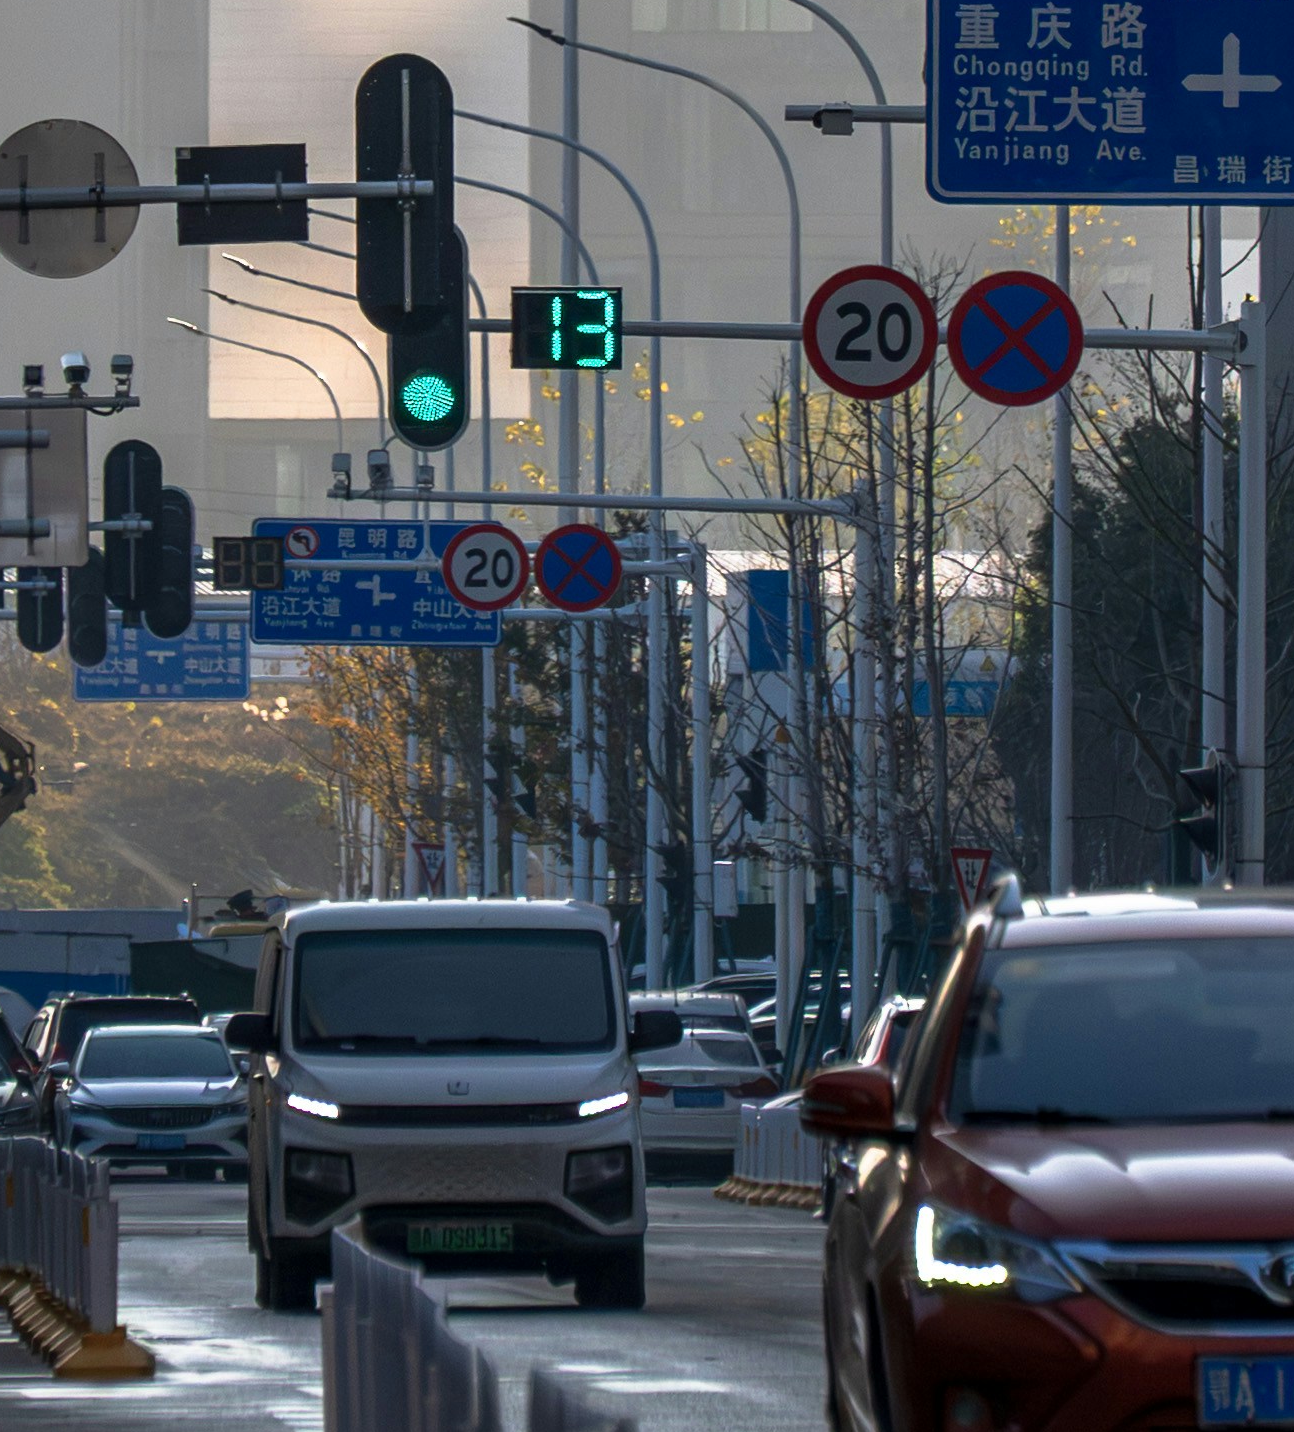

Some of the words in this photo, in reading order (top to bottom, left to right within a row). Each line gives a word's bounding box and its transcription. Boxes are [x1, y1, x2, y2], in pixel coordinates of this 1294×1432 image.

[954, 2, 1148, 50] 重庆路
[954, 54, 1090, 81] Chongqing
[1111, 55, 1148, 77] Rd.
[955, 87, 1148, 134] 沿江大道
[955, 137, 1069, 166] Yanjiang
[1096, 139, 1147, 161] Ave.
[1173, 155, 1293, 185] 昌瑞街
[552, 289, 616, 368] 13
[835, 301, 908, 363] 20
[464, 548, 514, 588] 20
[262, 597, 341, 618] 沿江大道
